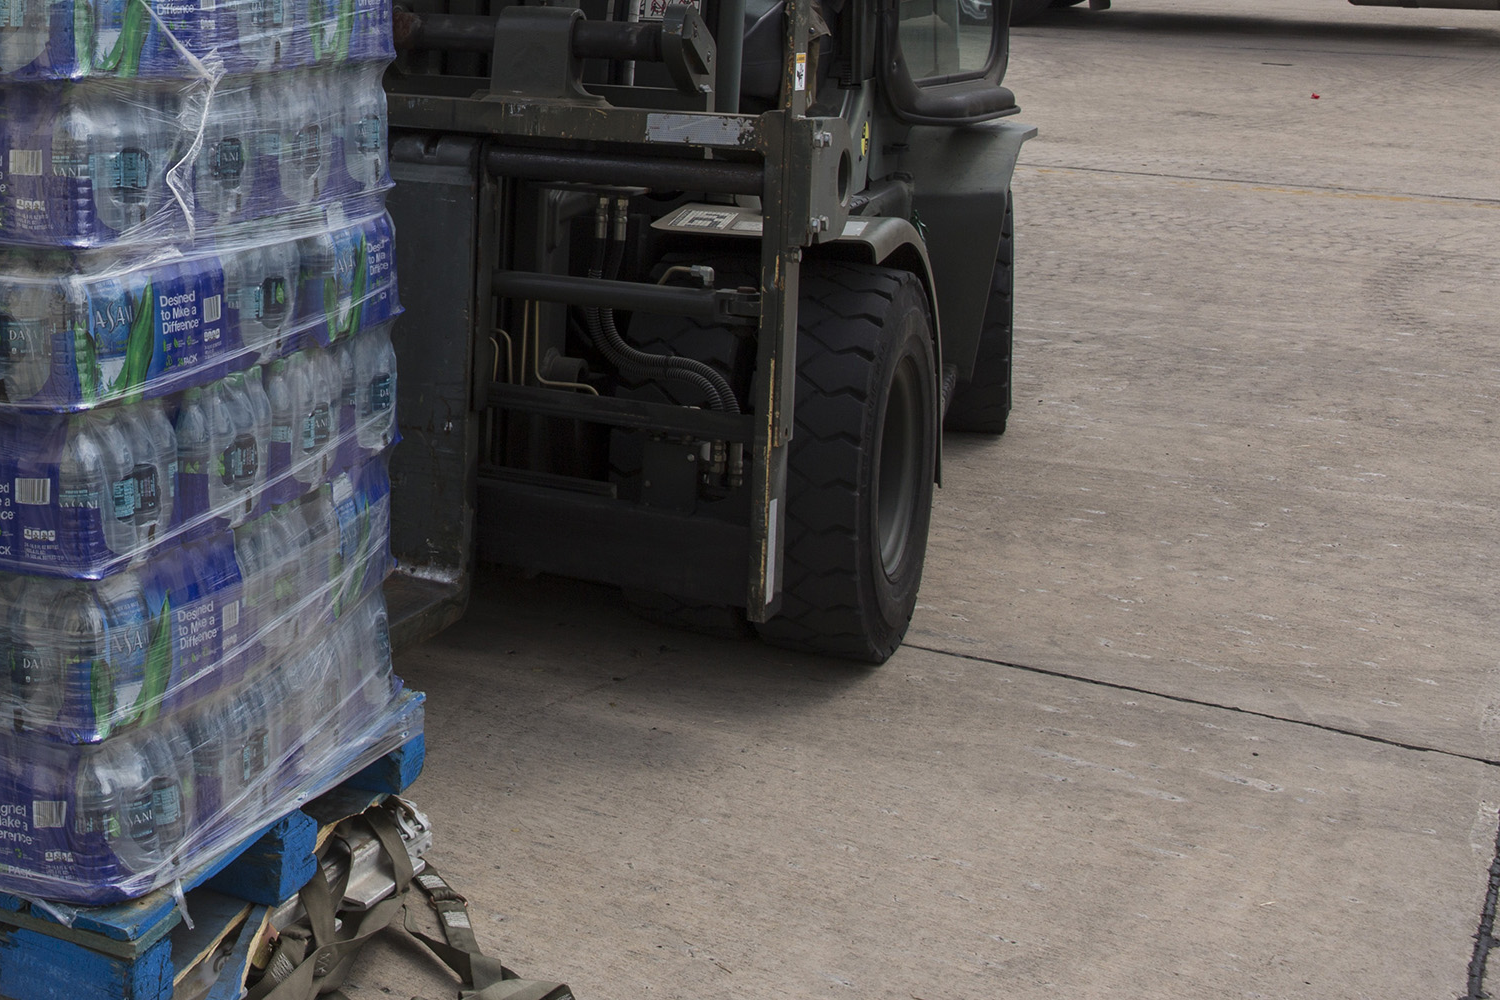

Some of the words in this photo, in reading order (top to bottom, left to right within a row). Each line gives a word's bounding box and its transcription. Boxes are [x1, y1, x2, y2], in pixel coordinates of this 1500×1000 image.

[160, 310, 171, 321] to
[191, 305, 198, 315] a
[4, 497, 11, 506] a
[179, 624, 189, 636] to
[208, 615, 215, 626] a
[23, 820, 29, 832] a
